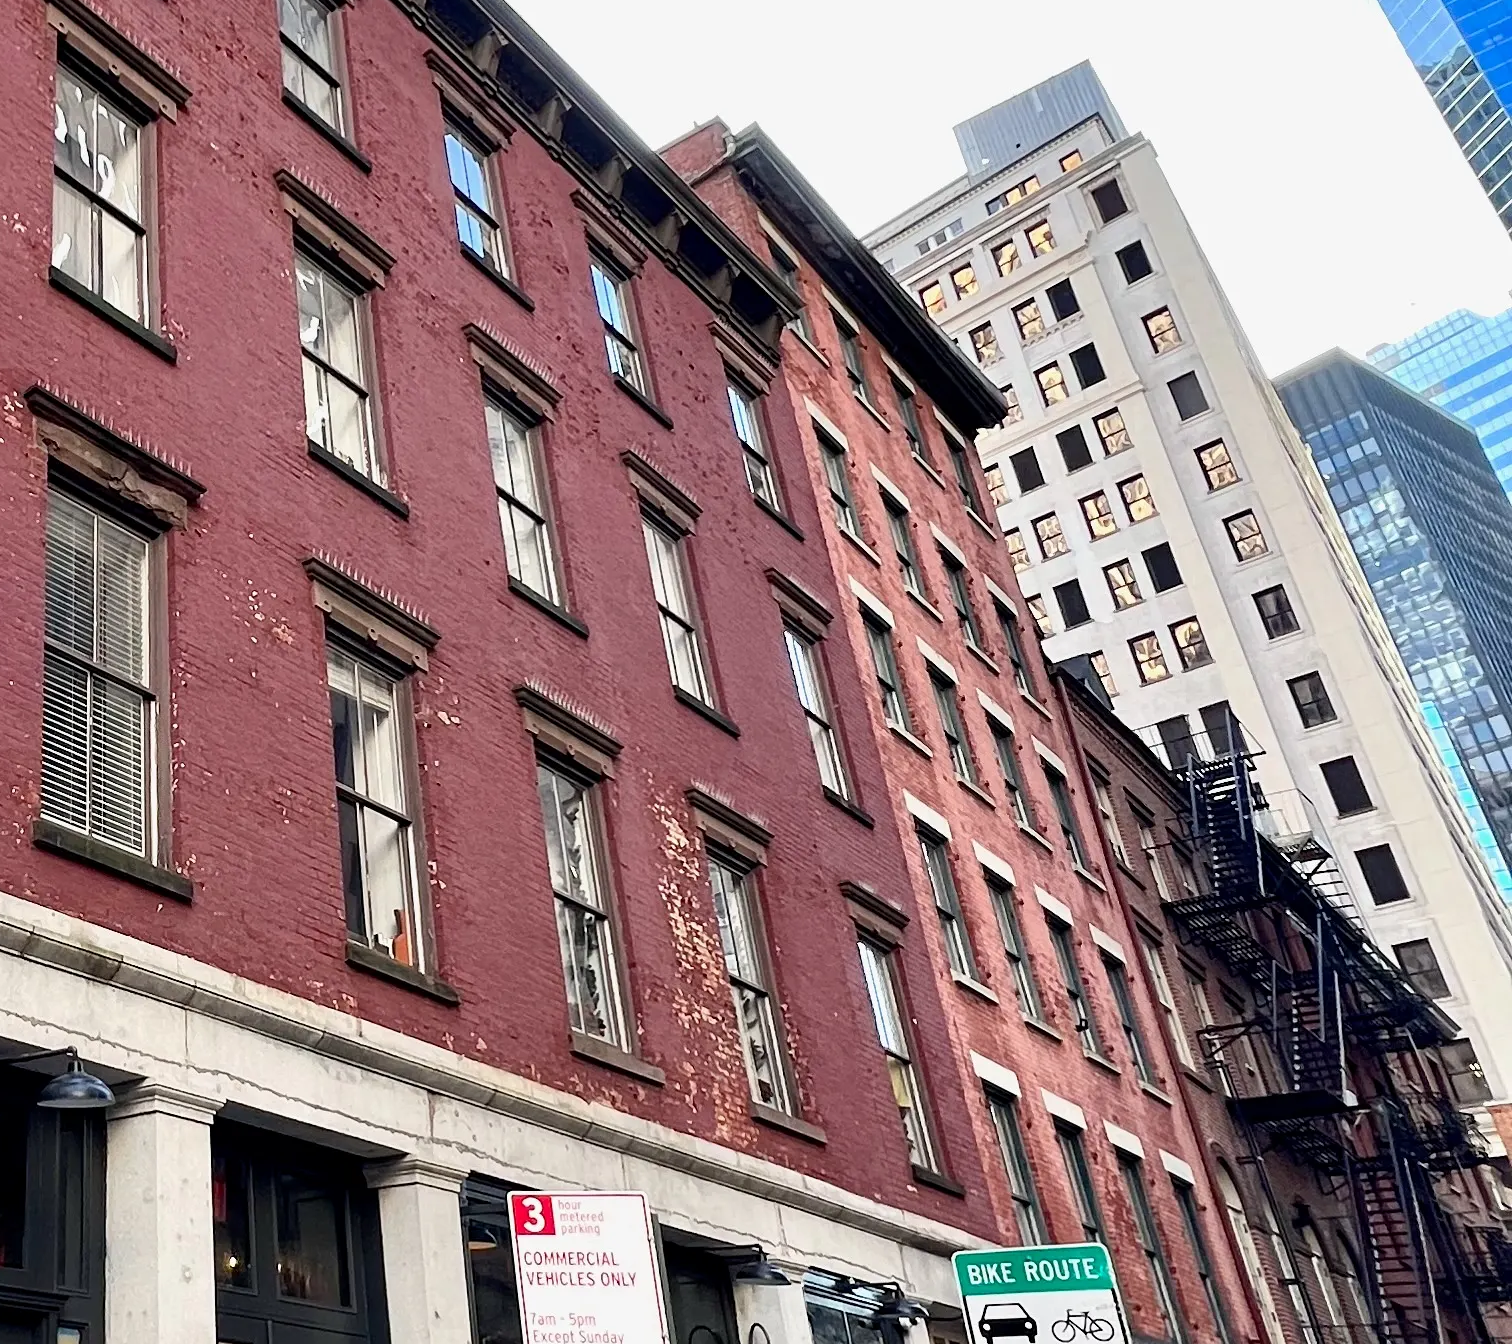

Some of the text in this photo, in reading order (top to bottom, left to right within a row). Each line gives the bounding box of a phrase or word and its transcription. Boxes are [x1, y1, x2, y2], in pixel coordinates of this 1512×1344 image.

[558, 1200, 581, 1210] hour
[522, 1197, 546, 1233] 3
[560, 1212, 604, 1222] metered
[561, 1224, 601, 1236] parking
[524, 1251, 620, 1266] COMMERCIAL
[966, 1257, 1100, 1285] BIKE ROUTE
[526, 1271, 636, 1287] VEHICLES ONLY
[530, 1312, 557, 1326] 7am
[569, 1312, 597, 1329] 5pm
